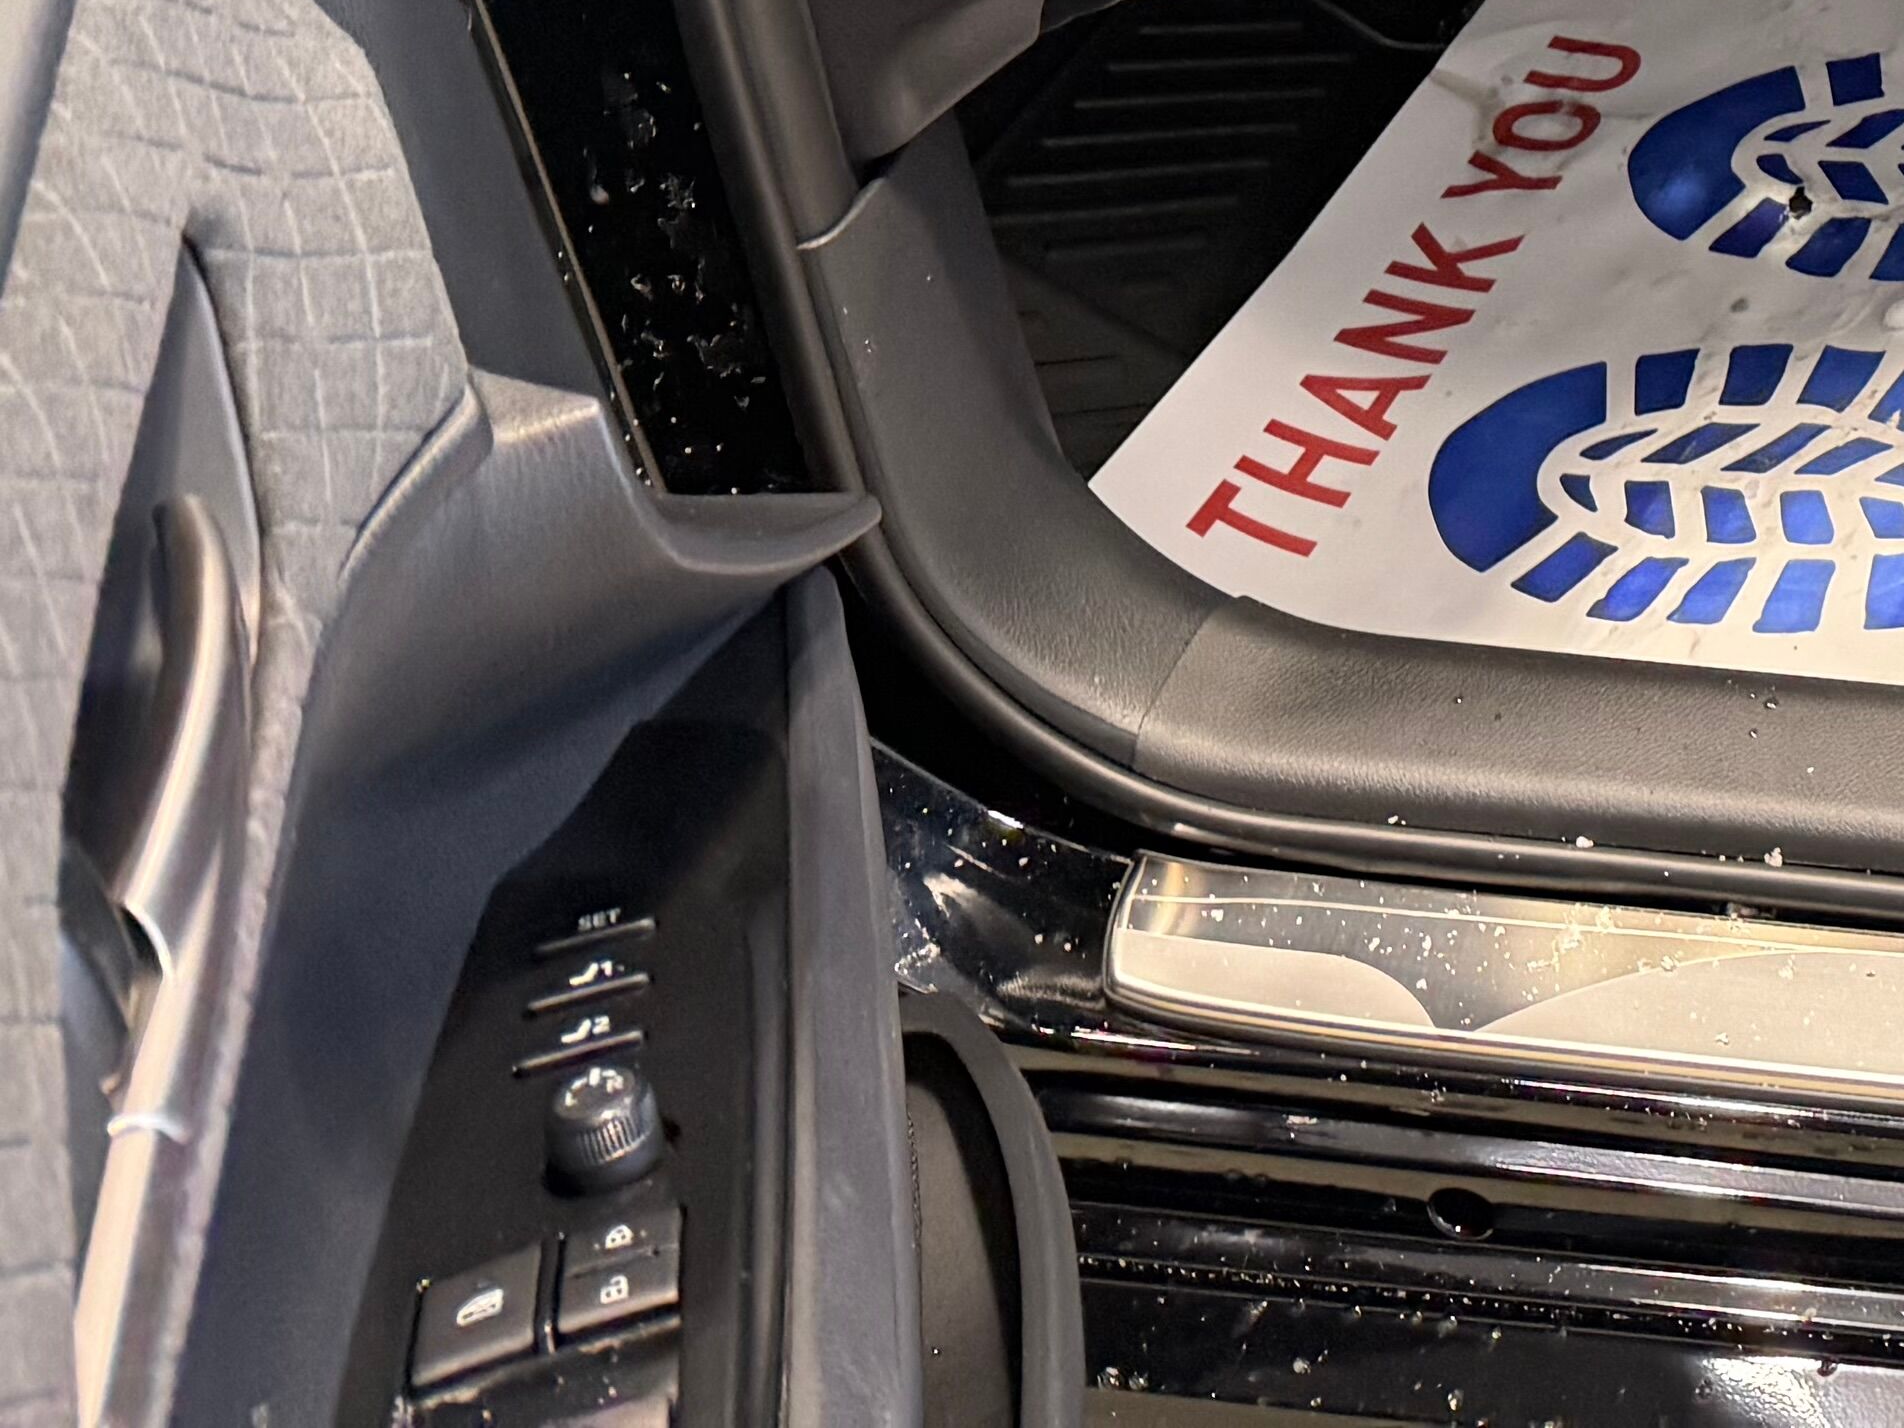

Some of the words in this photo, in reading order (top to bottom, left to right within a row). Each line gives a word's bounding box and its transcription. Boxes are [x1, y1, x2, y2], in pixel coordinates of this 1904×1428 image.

[1186, 225, 1522, 558] THANK
[1440, 36, 1642, 200] YOU
[577, 907, 622, 932] SET
